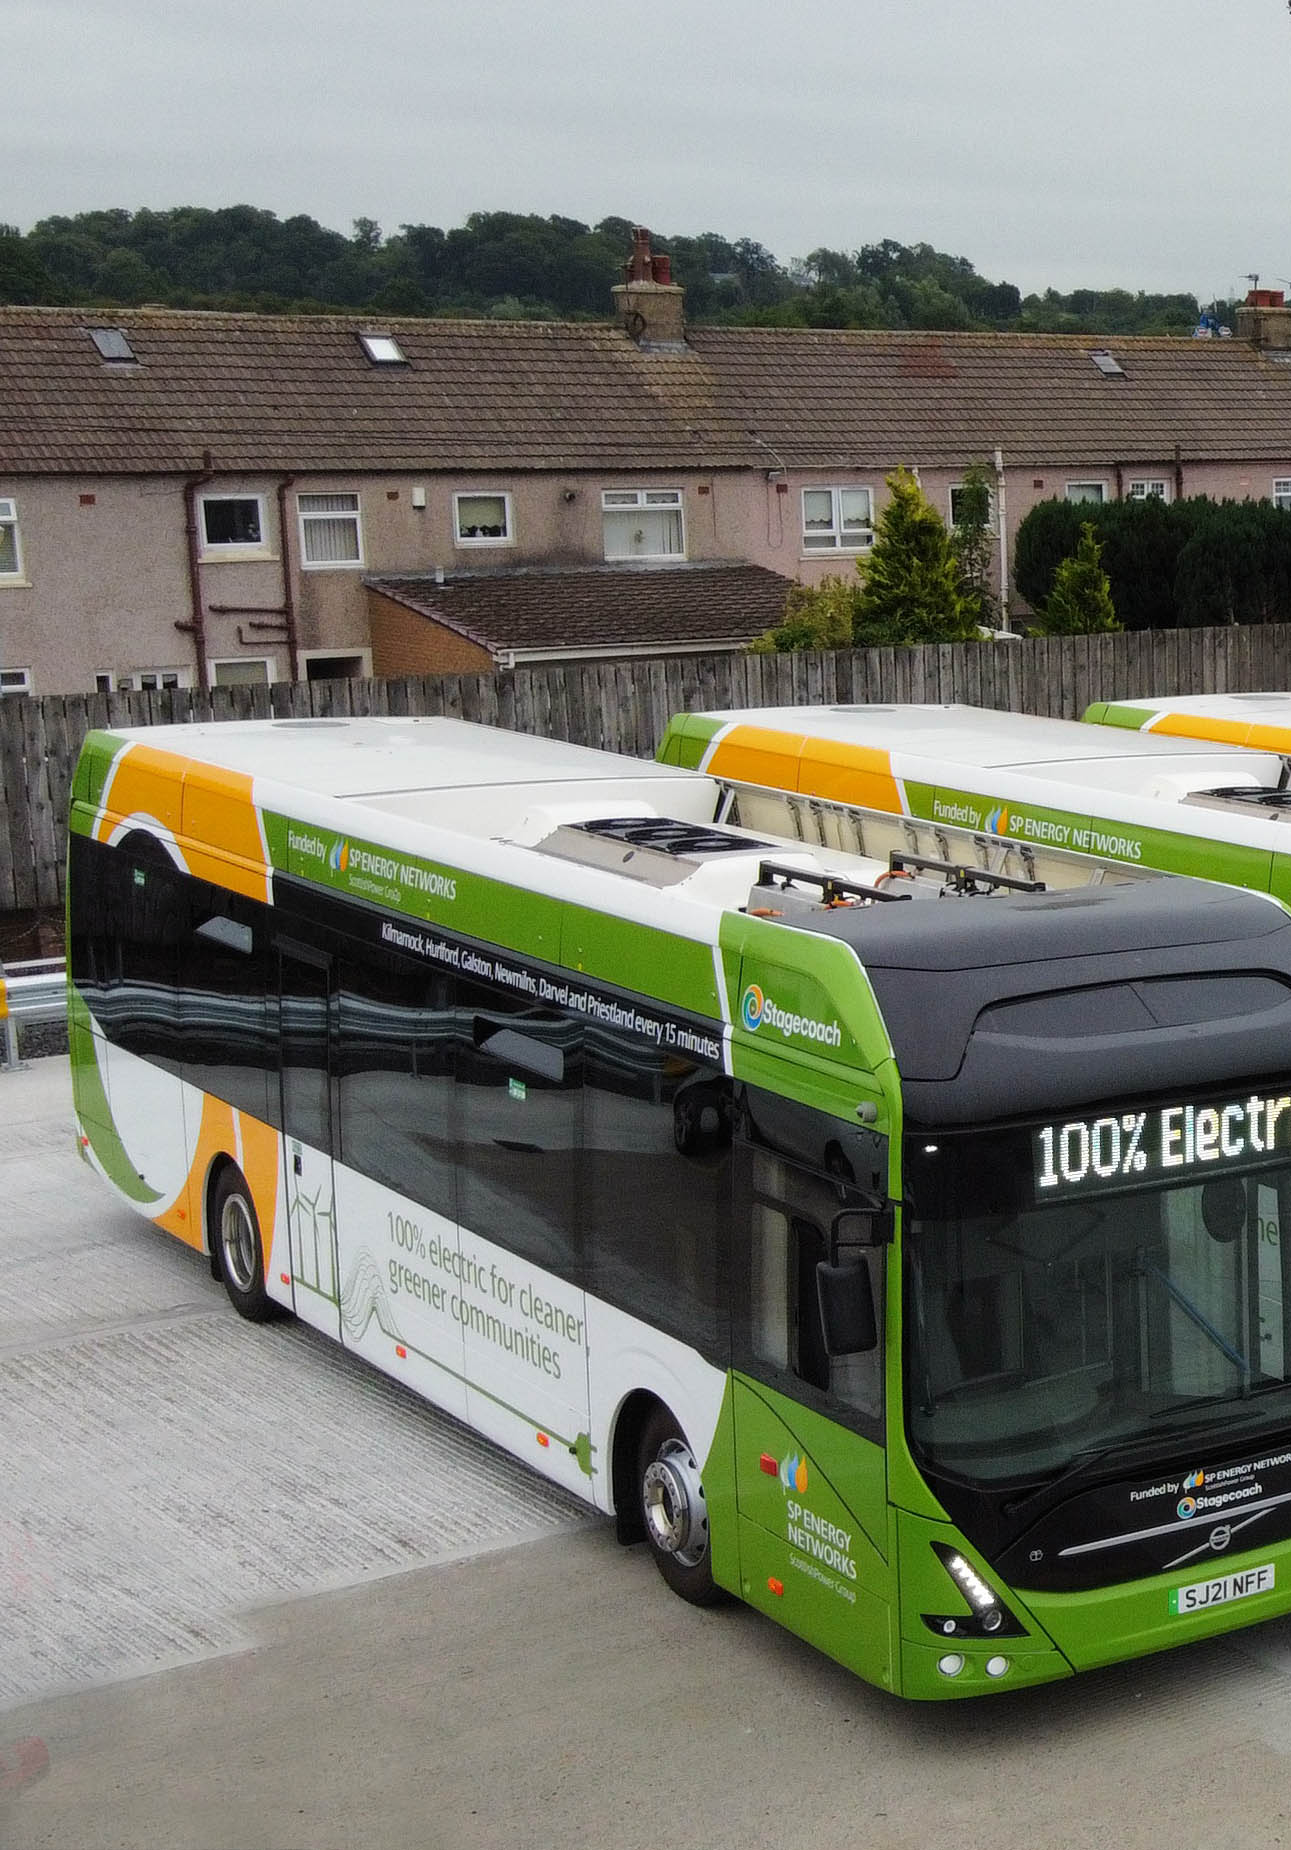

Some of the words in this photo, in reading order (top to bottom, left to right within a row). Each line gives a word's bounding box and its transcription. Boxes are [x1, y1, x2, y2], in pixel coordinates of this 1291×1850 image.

[934, 800, 968, 823] Funded
[968, 806, 982, 830] by
[1010, 815, 1024, 833] SP
[1024, 818, 1071, 843] ENERGY
[1072, 831, 1142, 859] NETWORKS
[288, 829, 317, 855] Funded
[317, 838, 327, 863] by
[350, 848, 361, 866] SP
[362, 853, 399, 880] ENERGY
[400, 864, 457, 900] NETWORKS
[425, 938, 461, 968] Hurlford,
[461, 951, 494, 981] Galston,
[494, 963, 538, 997] Newmilns,
[539, 978, 568, 1005] Darvel
[568, 992, 587, 1012] and
[588, 995, 634, 1028] Priestland
[635, 1016, 665, 1045] every
[664, 1022, 677, 1044] 15
[677, 1029, 720, 1060] minutes
[763, 998, 841, 1047] Stagecoach
[1038, 1113, 1148, 1187] 100%
[387, 1211, 425, 1260] 100%
[429, 1235, 487, 1293] electric
[490, 1264, 515, 1307] for
[520, 1283, 584, 1346] cleaner
[389, 1259, 447, 1312] greener
[451, 1295, 561, 1379] communities
[1130, 1484, 1166, 1501] Funded
[1167, 1483, 1179, 1494] by
[1204, 1473, 1216, 1484] SP
[1216, 1464, 1252, 1480] ENERGY
[1196, 1483, 1262, 1509] Stagecoach
[787, 1500, 801, 1521] SP
[803, 1509, 851, 1552] ENERGY
[787, 1522, 856, 1579] NETWORKS
[1185, 1580, 1227, 1608] SJ21
[1233, 1570, 1268, 1597] NFF
